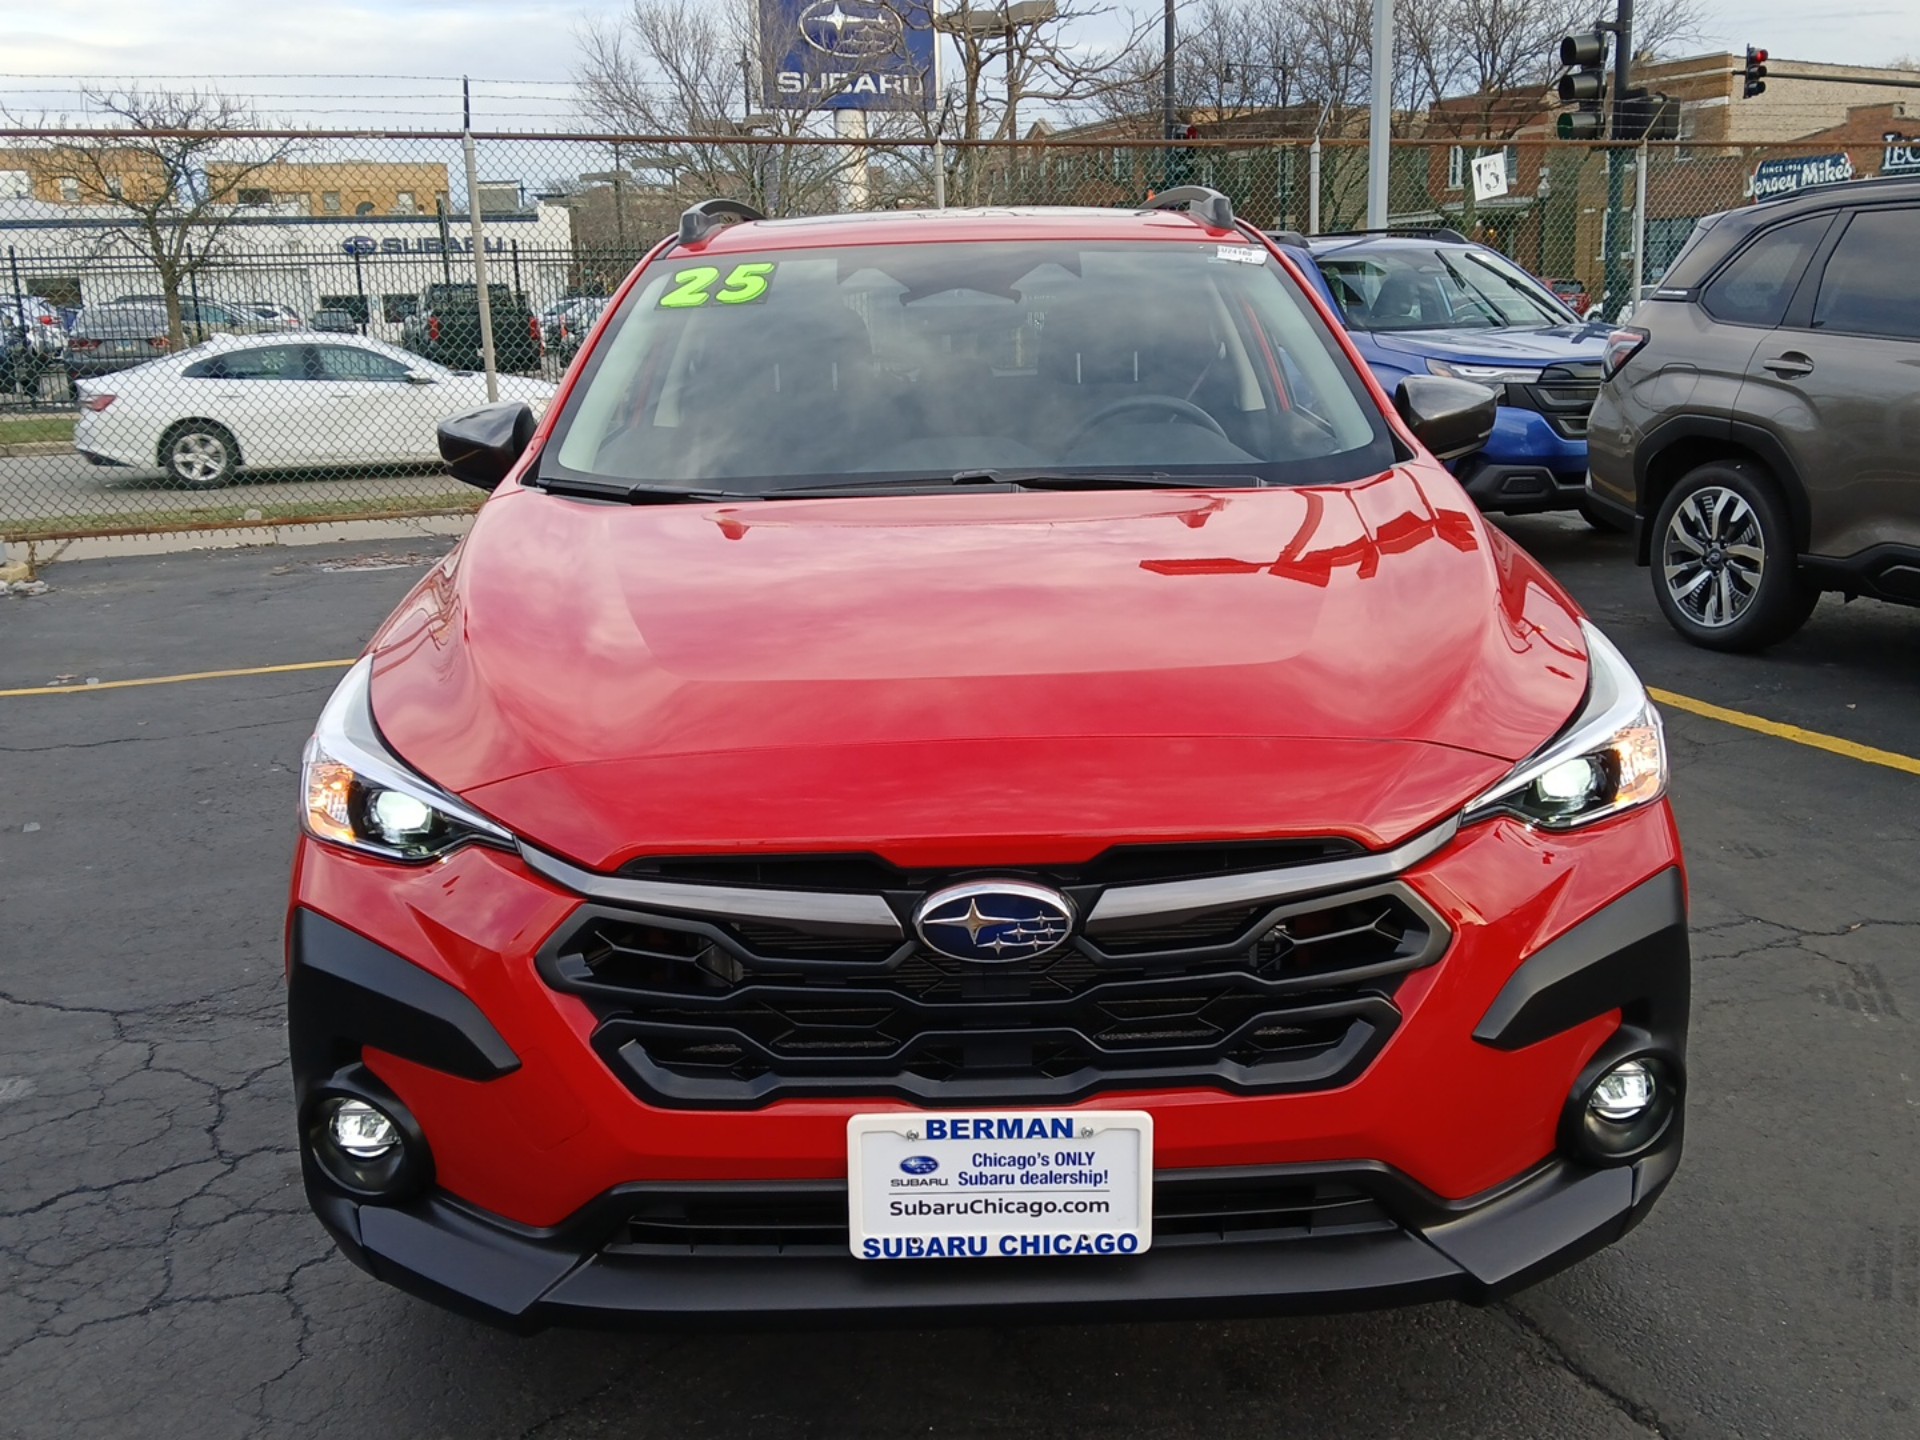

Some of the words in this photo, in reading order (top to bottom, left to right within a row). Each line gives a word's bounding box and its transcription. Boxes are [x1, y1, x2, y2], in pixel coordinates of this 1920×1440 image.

[777, 71, 923, 95] SUBARU
[1743, 173, 1797, 197] Jersey
[1801, 158, 1853, 185] Mike's
[1761, 165, 1783, 174] SINCE
[659, 262, 775, 308] 25
[925, 1117, 1074, 1140] BERMAN
[971, 1152, 1050, 1170] Chicago's
[1054, 1151, 1096, 1167] ONLY
[890, 1178, 949, 1187] SUBARU
[957, 1171, 1015, 1186] Subaru
[1020, 1169, 1109, 1187] dealership!
[890, 1198, 1110, 1217] SubaruChicago.com
[862, 1235, 987, 1259] SUBARU
[998, 1233, 1139, 1255] CHICAGO
